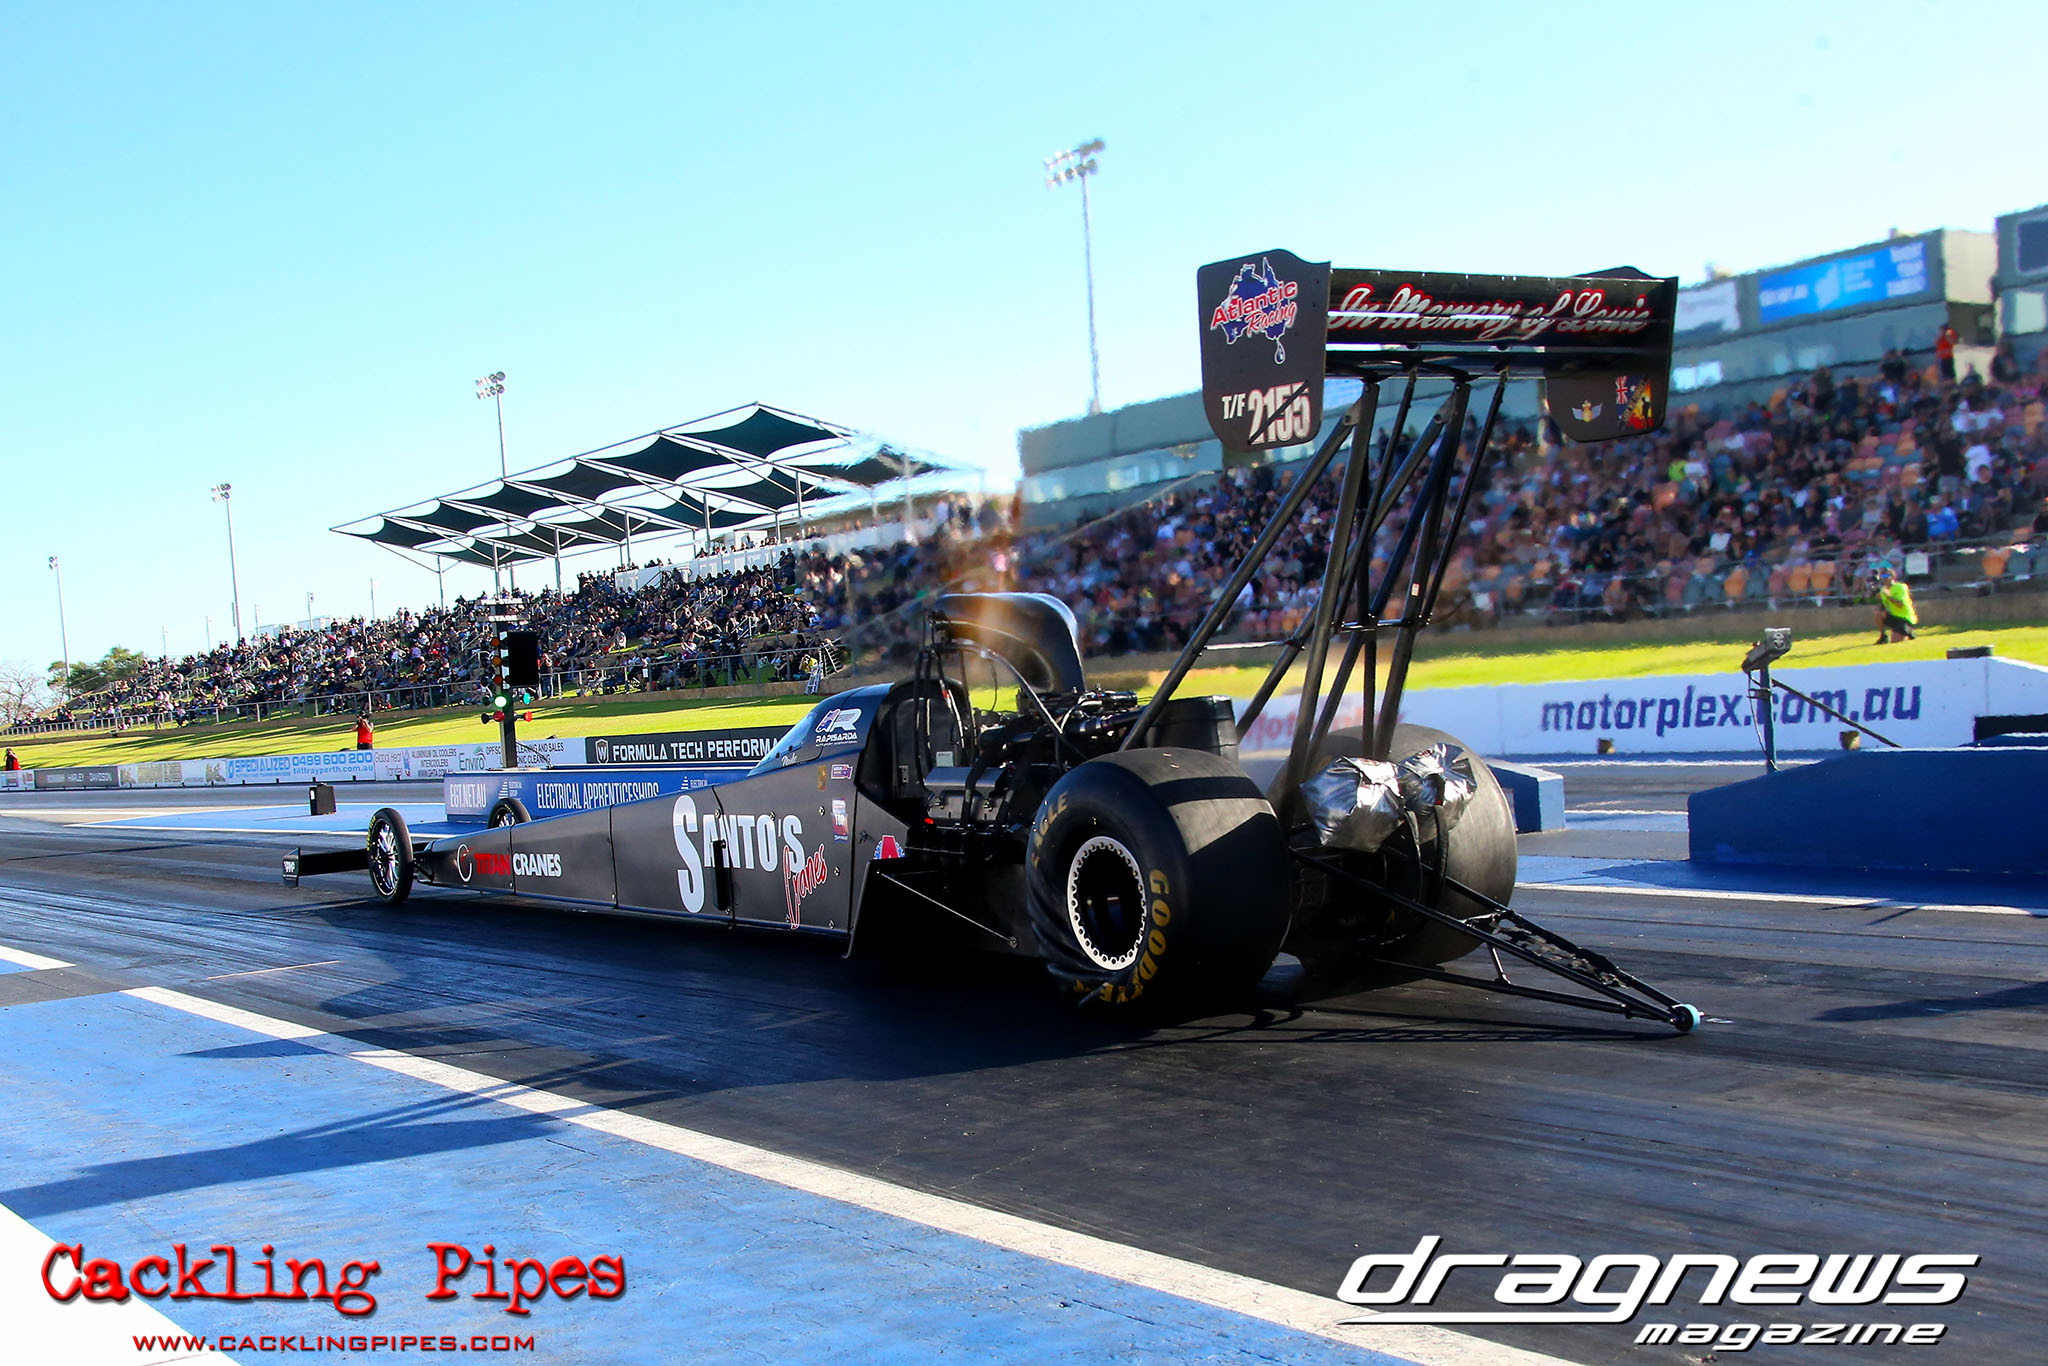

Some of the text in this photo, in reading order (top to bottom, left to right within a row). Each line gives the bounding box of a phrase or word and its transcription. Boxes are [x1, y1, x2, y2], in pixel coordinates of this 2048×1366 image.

[1210, 281, 1298, 330] Atlantic
[1246, 301, 1297, 337] Racing
[1328, 283, 1379, 330] In
[1380, 283, 1512, 341] Memory
[1516, 289, 1573, 341] of
[1222, 380, 1311, 446] T/F 2155
[1541, 684, 1922, 737] motorplex.com.au
[612, 743, 668, 761] FORMULA
[671, 741, 704, 759] TECH
[815, 732, 858, 742] RAPISARDA
[235, 757, 291, 773] SPECIALIZED
[292, 752, 373, 766] 0499 600 200
[536, 782, 659, 809] ELECTRICAL APPRENTICESHIPS
[473, 852, 562, 877] TITAN CRANES
[672, 795, 804, 913] SANTO'S
